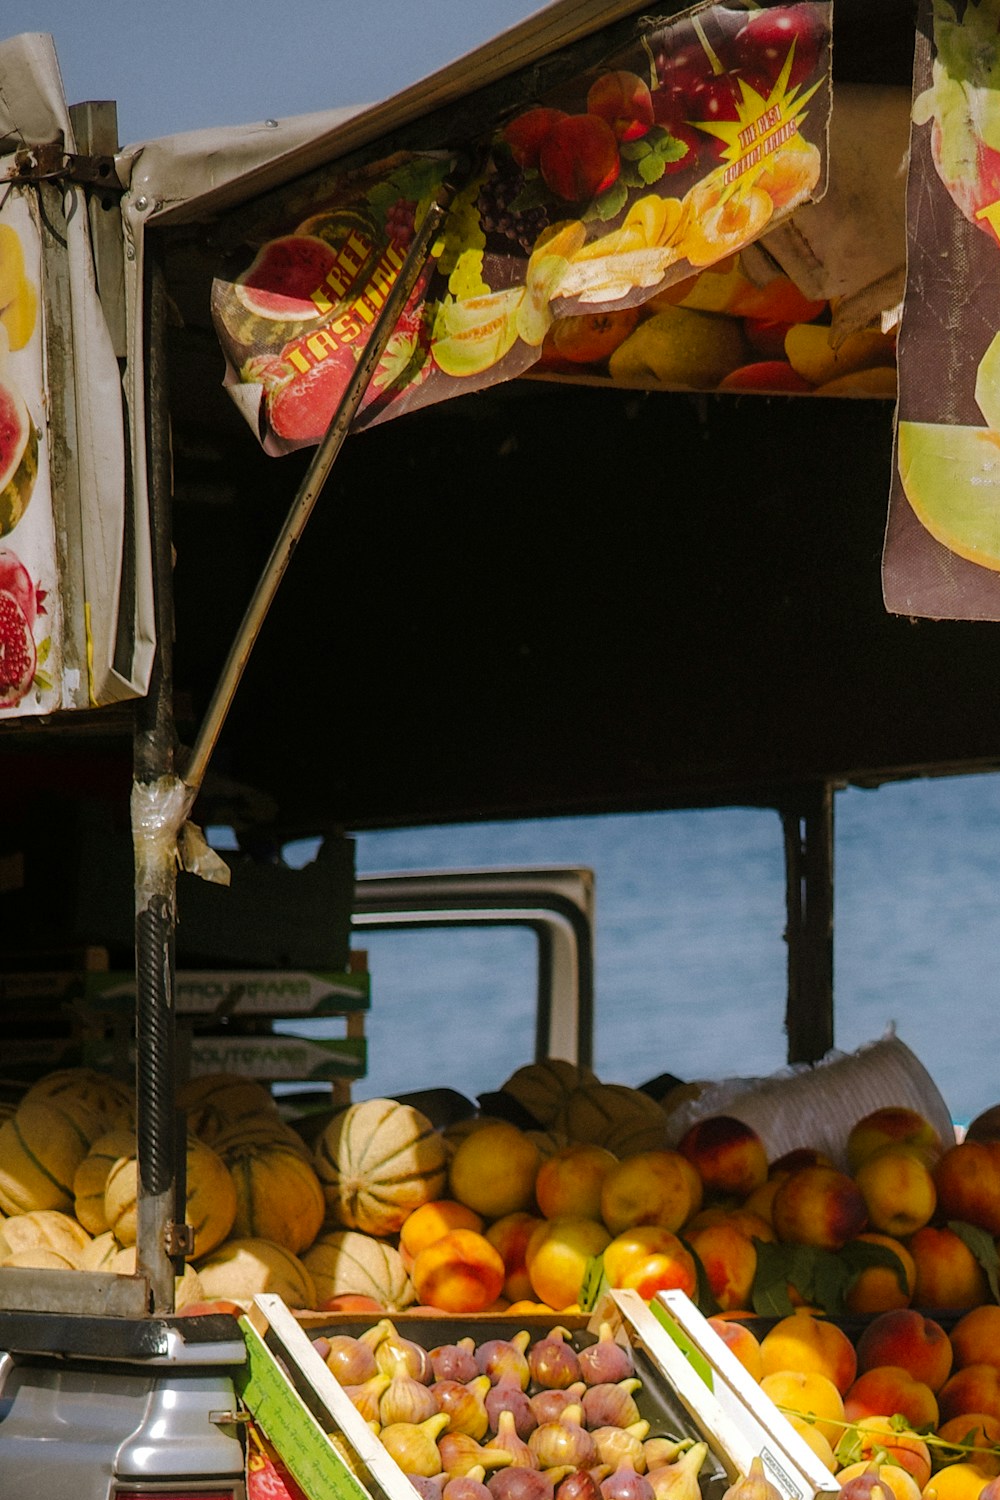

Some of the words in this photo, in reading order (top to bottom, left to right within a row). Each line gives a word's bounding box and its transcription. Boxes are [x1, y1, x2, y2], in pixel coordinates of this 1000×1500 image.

[738, 123, 757, 151] THE
[757, 104, 782, 136] BEST
[308, 229, 373, 316] FREE
